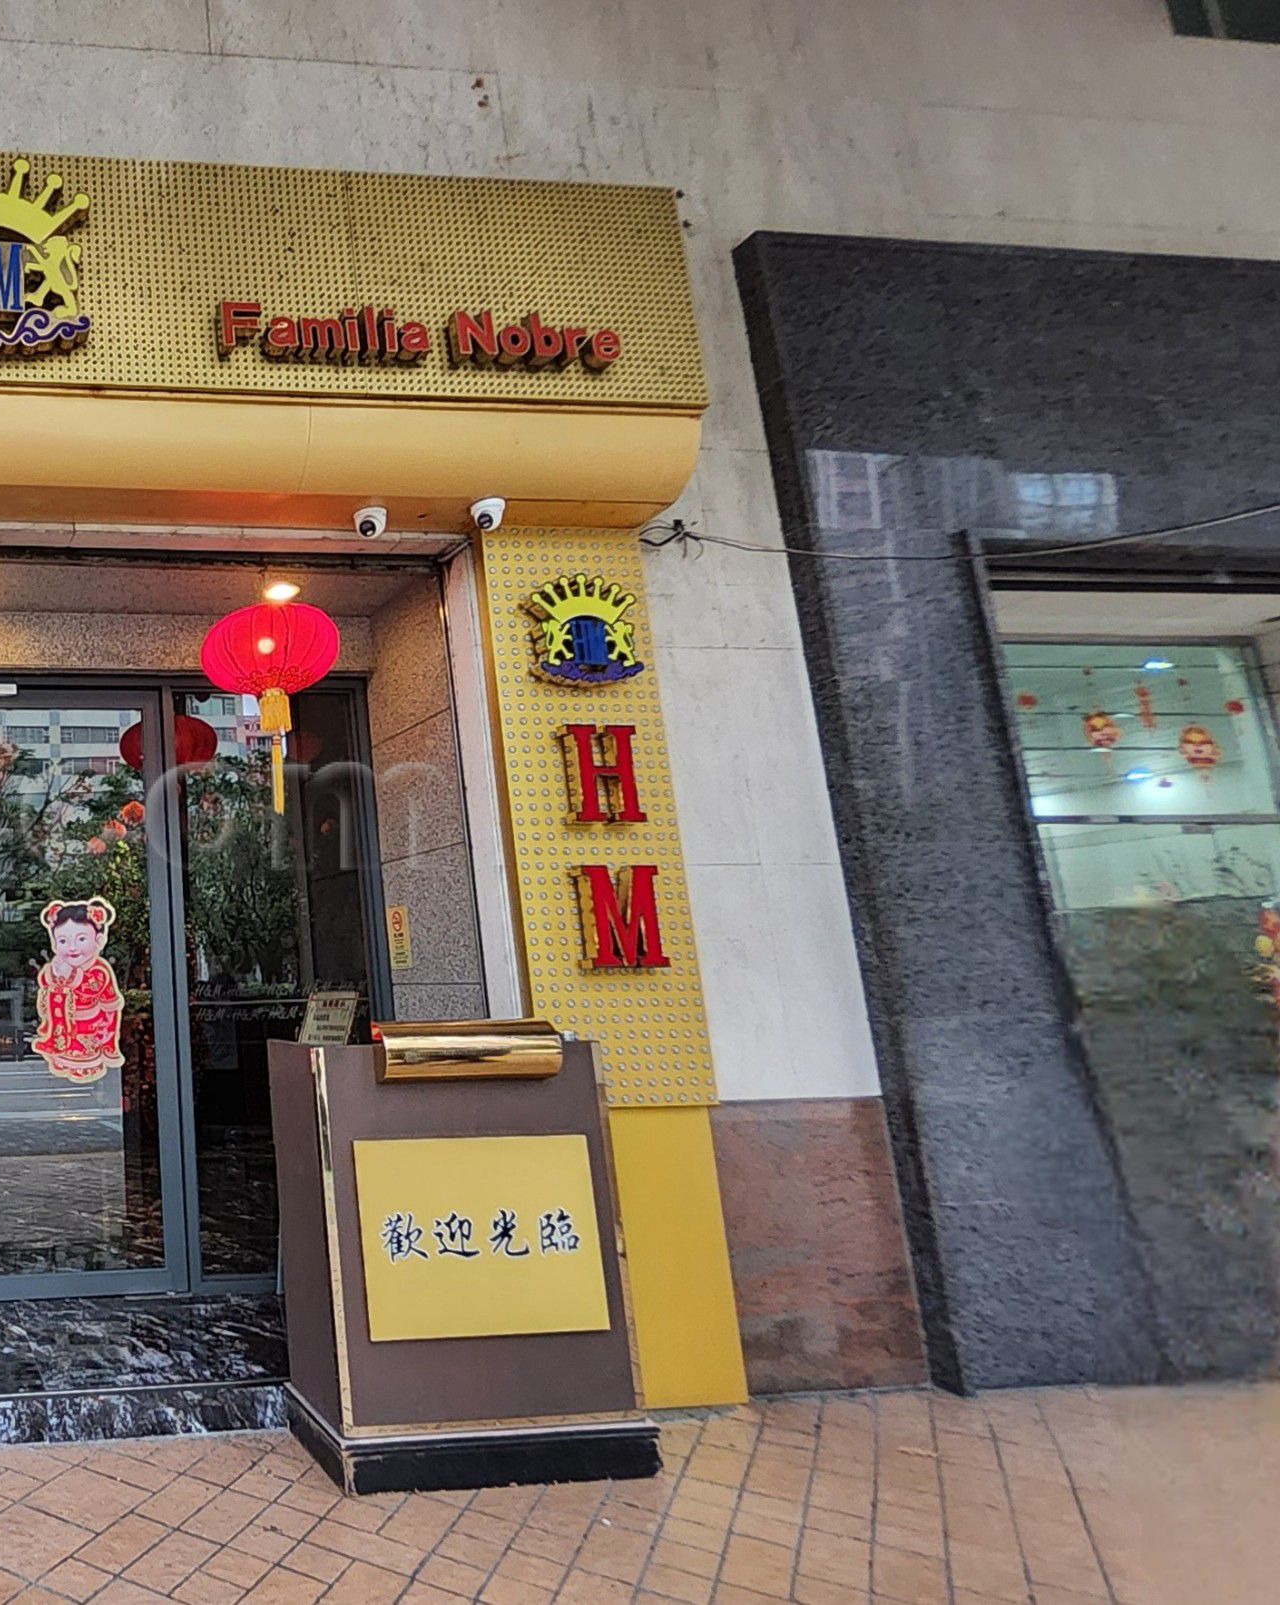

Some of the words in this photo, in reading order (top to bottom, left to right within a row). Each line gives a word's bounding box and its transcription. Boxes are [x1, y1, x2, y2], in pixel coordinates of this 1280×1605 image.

[220, 300, 430, 354] Familia
[455, 308, 621, 362] Nobre
[381, 1207, 580, 1263] 歡迎光臨
